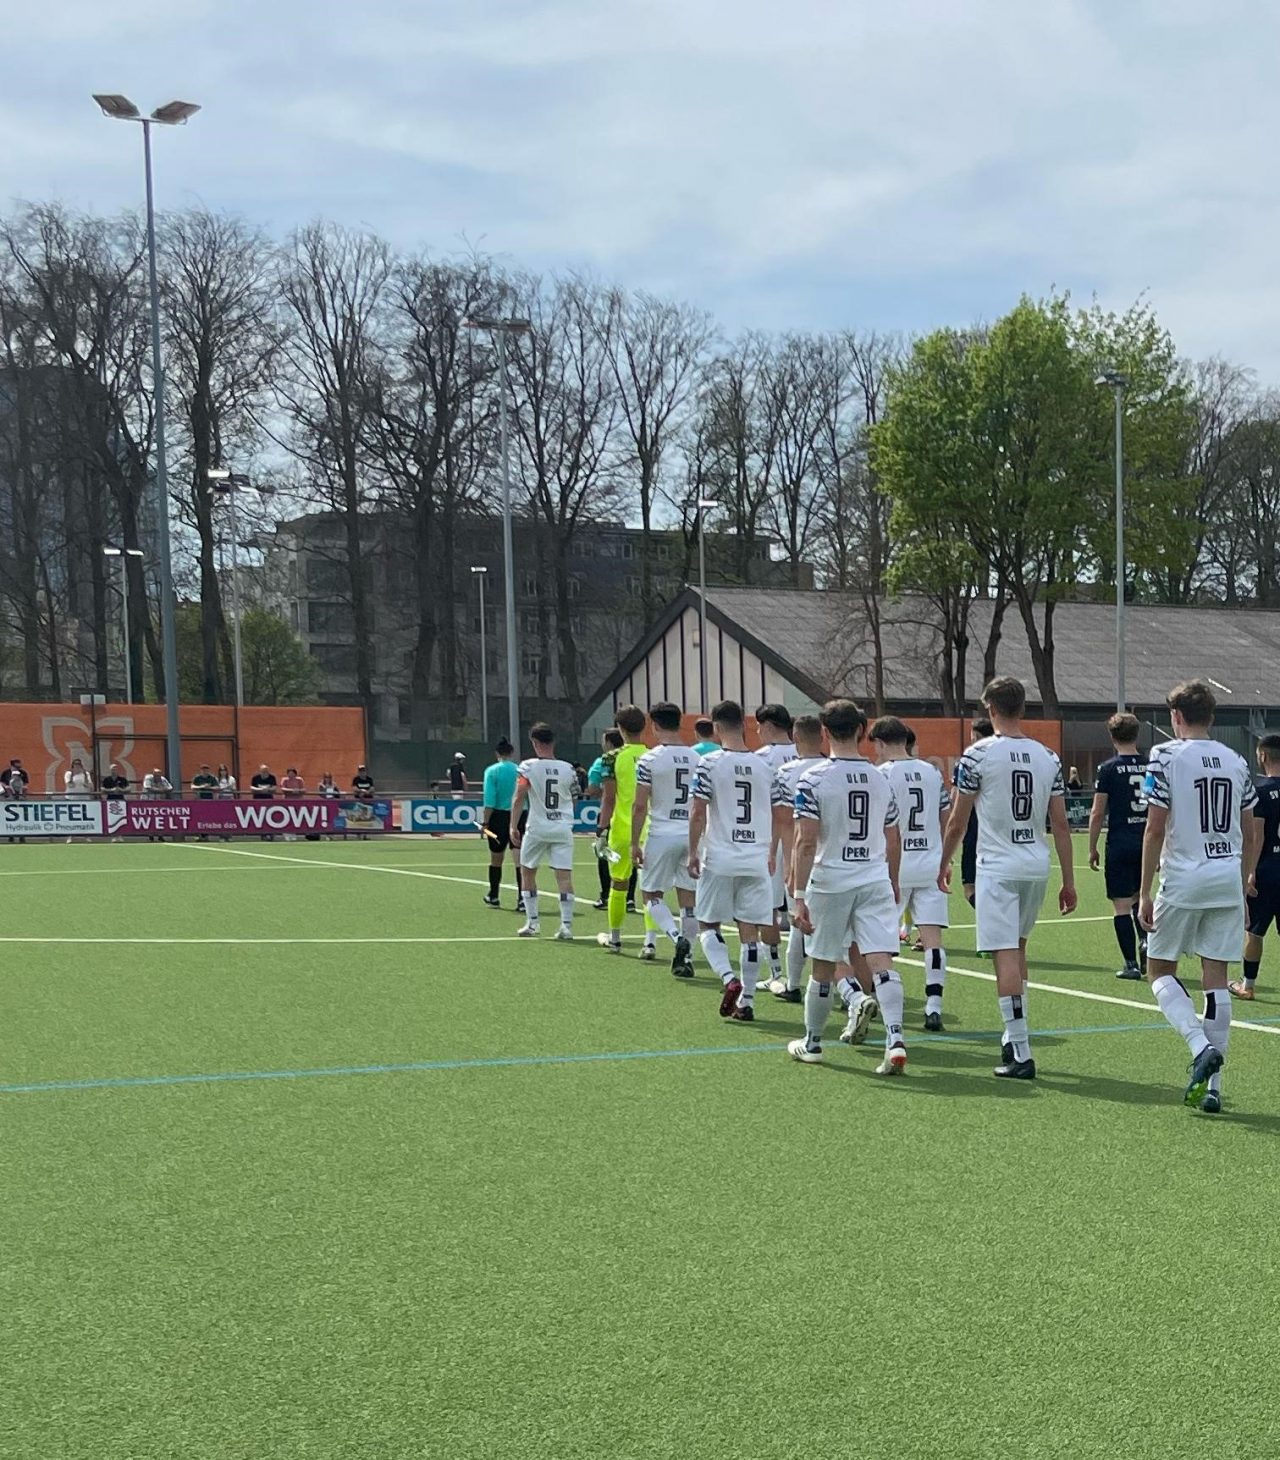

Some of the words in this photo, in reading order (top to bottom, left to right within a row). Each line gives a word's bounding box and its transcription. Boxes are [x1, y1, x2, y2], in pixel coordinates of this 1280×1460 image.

[1202, 756, 1221, 769] ULM
[846, 773, 868, 784] ULM
[674, 768, 689, 804] 5
[545, 779, 559, 810] 6
[1011, 770, 1034, 821] 8
[1128, 775, 1149, 812] 3
[734, 781, 752, 825] 3
[908, 788, 925, 832] 2
[1194, 777, 1233, 834] 10
[4, 803, 96, 822] STIEFEL
[131, 807, 191, 816] RUTSCHEN
[235, 805, 328, 829] WOW!
[848, 791, 869, 841] 9
[6, 823, 41, 832] Hydraulik
[55, 823, 96, 831] Pneumatik
[131, 816, 191, 830] WELT
[197, 822, 222, 830] Erlebe
[734, 829, 755, 840] PERI
[1013, 828, 1034, 841] PERI
[906, 838, 928, 849] PERI
[1207, 842, 1232, 856] PERI
[845, 846, 870, 858] PERI
